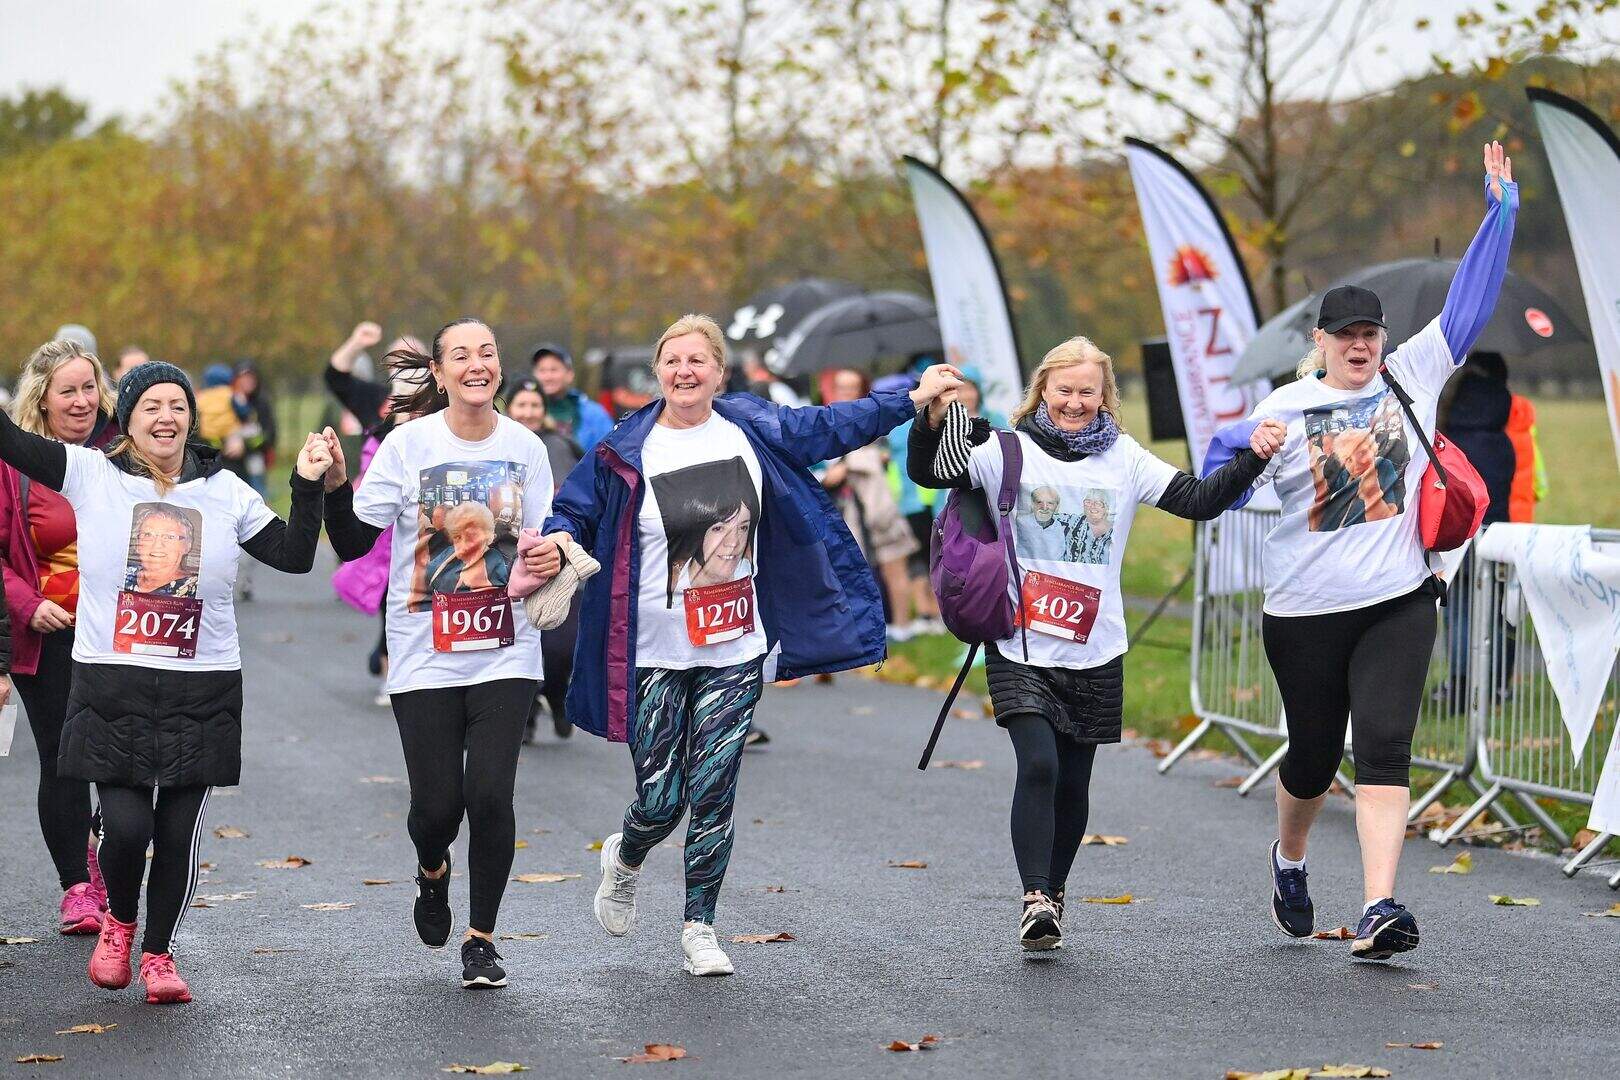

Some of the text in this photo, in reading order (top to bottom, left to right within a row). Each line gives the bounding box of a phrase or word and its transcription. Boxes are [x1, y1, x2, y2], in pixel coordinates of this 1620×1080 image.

[118, 608, 196, 640] 2074
[440, 604, 506, 635] 1967
[695, 596, 748, 629] 1270
[1031, 593, 1084, 624] 402
